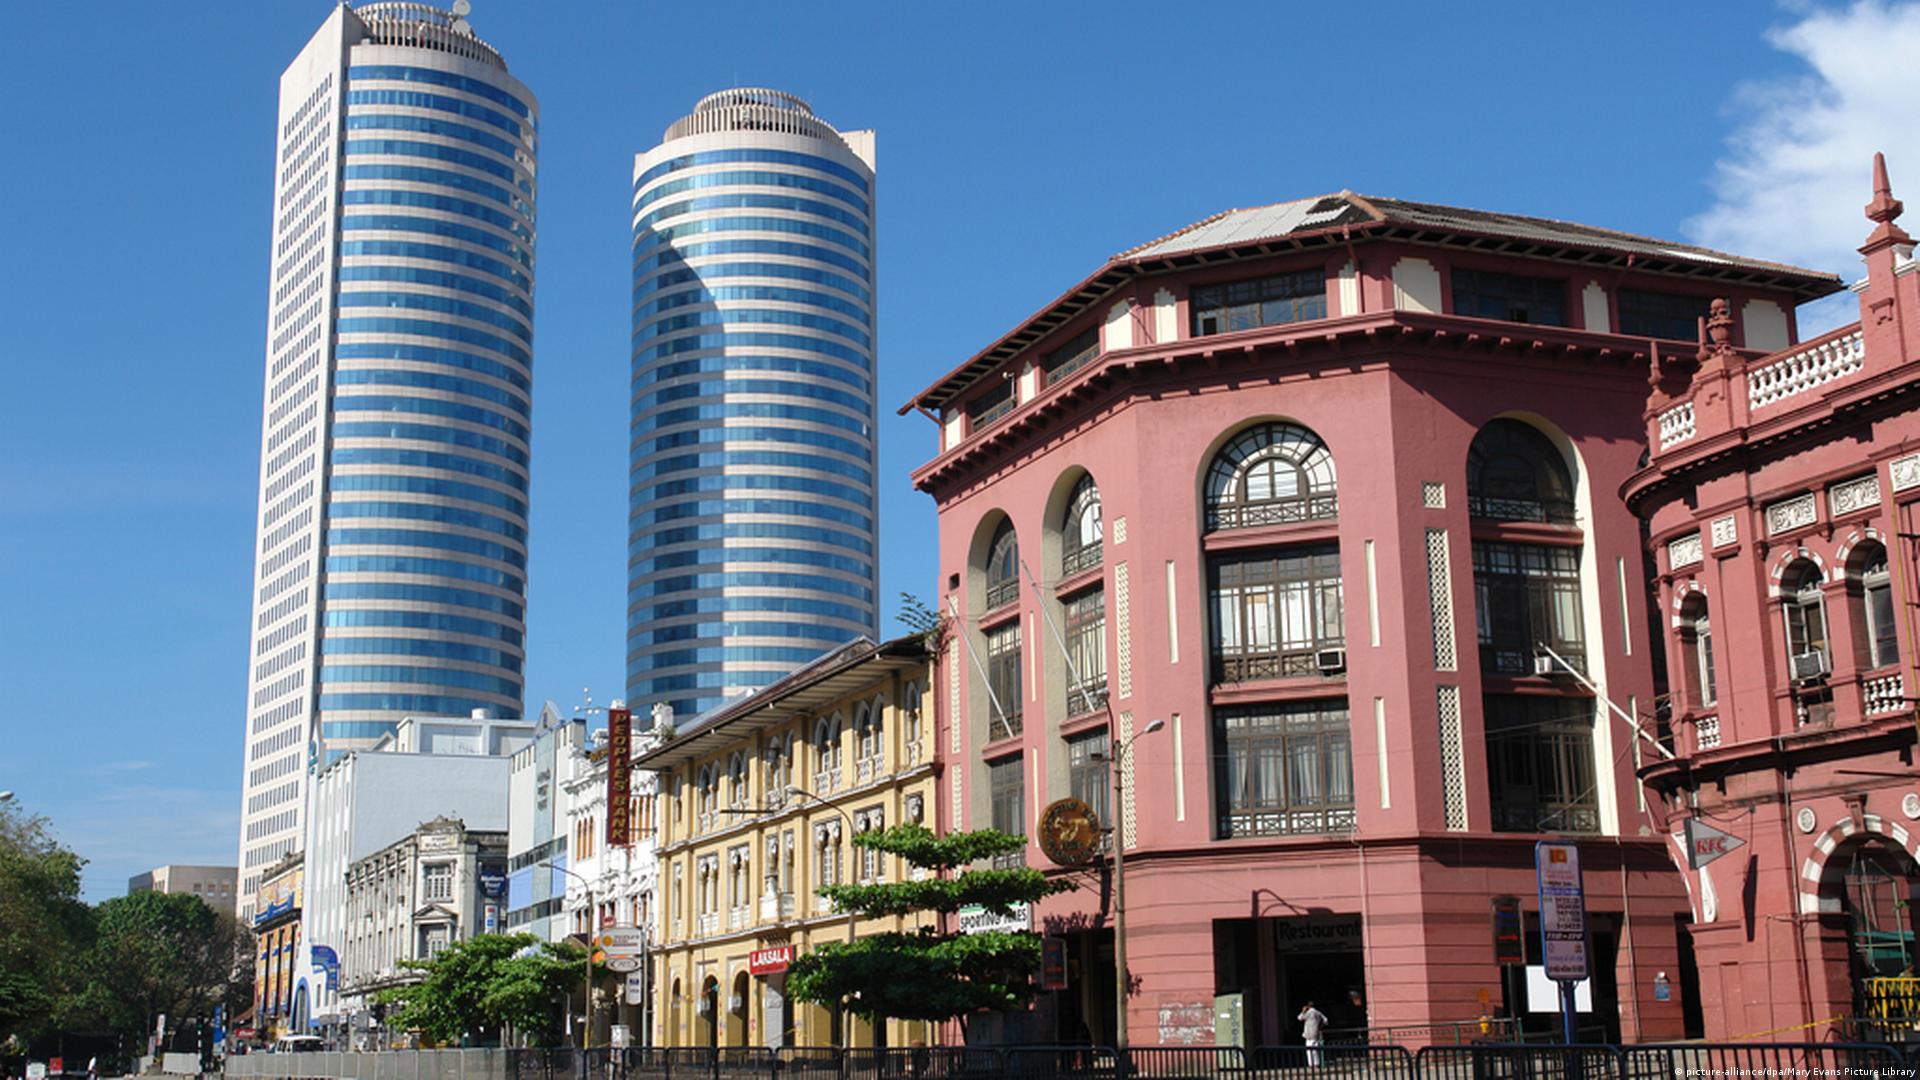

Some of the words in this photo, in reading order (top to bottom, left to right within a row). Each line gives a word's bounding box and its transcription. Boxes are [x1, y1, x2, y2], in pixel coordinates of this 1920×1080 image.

[612, 796, 626, 839] BANK
[1695, 836, 1727, 854] KFC
[1280, 920, 1361, 940] Restaurant
